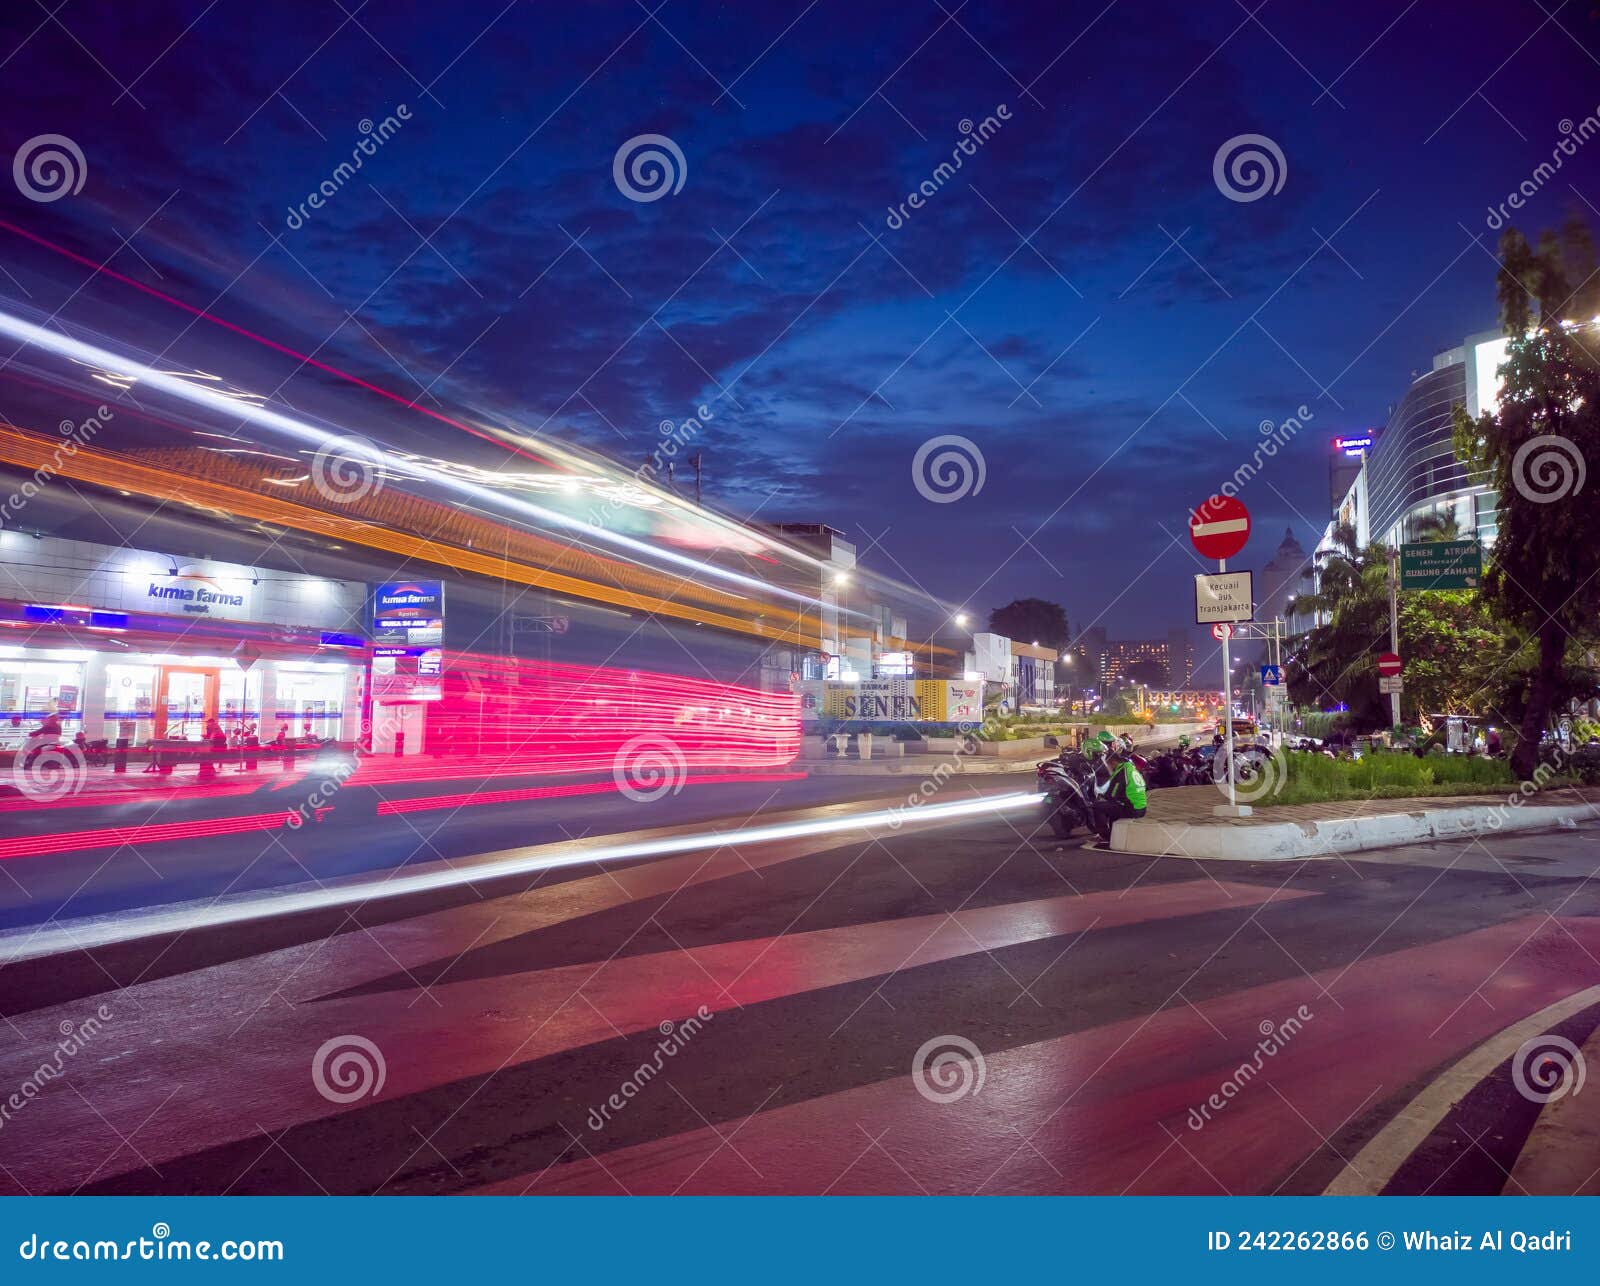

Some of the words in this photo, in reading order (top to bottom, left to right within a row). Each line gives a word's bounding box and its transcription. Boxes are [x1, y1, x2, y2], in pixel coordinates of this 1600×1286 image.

[1405, 549, 1433, 557] SENEN
[1444, 546, 1477, 556] ATRIUM
[1405, 569, 1440, 577] GUNUNG
[1209, 580, 1239, 591] Kecuali
[148, 583, 195, 600] kimia
[196, 588, 244, 606] farma
[382, 595, 407, 604] kimia
[407, 595, 435, 603] farma
[1200, 603, 1250, 613] Transjakarta
[845, 695, 923, 717] SENEN
